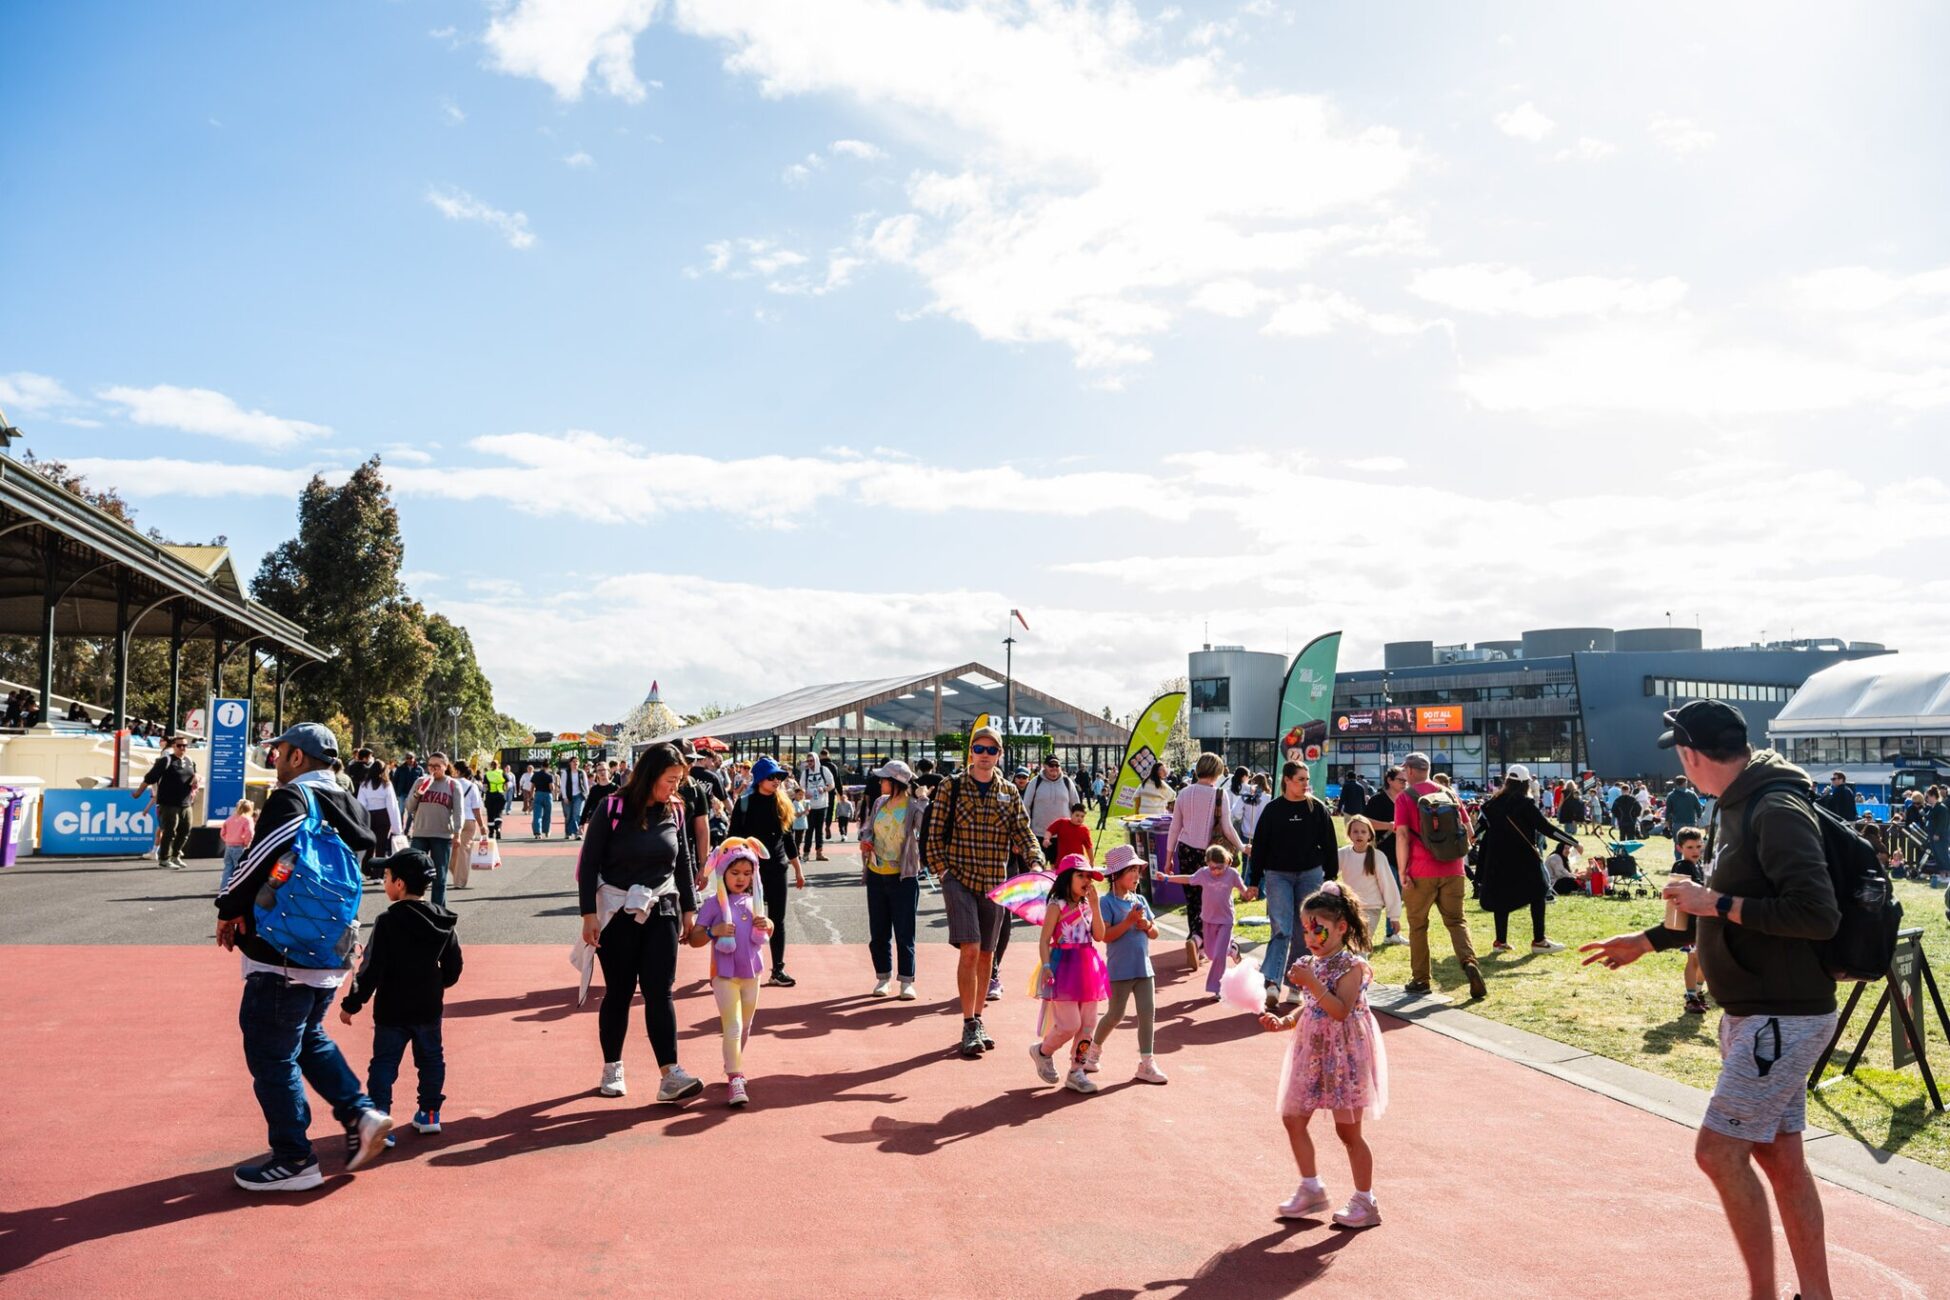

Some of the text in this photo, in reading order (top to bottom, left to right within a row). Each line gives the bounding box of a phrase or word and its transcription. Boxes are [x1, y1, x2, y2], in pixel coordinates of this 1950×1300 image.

[989, 715, 1043, 736] RAZE
[528, 748, 552, 759] SUSH
[54, 801, 154, 834] cirka
